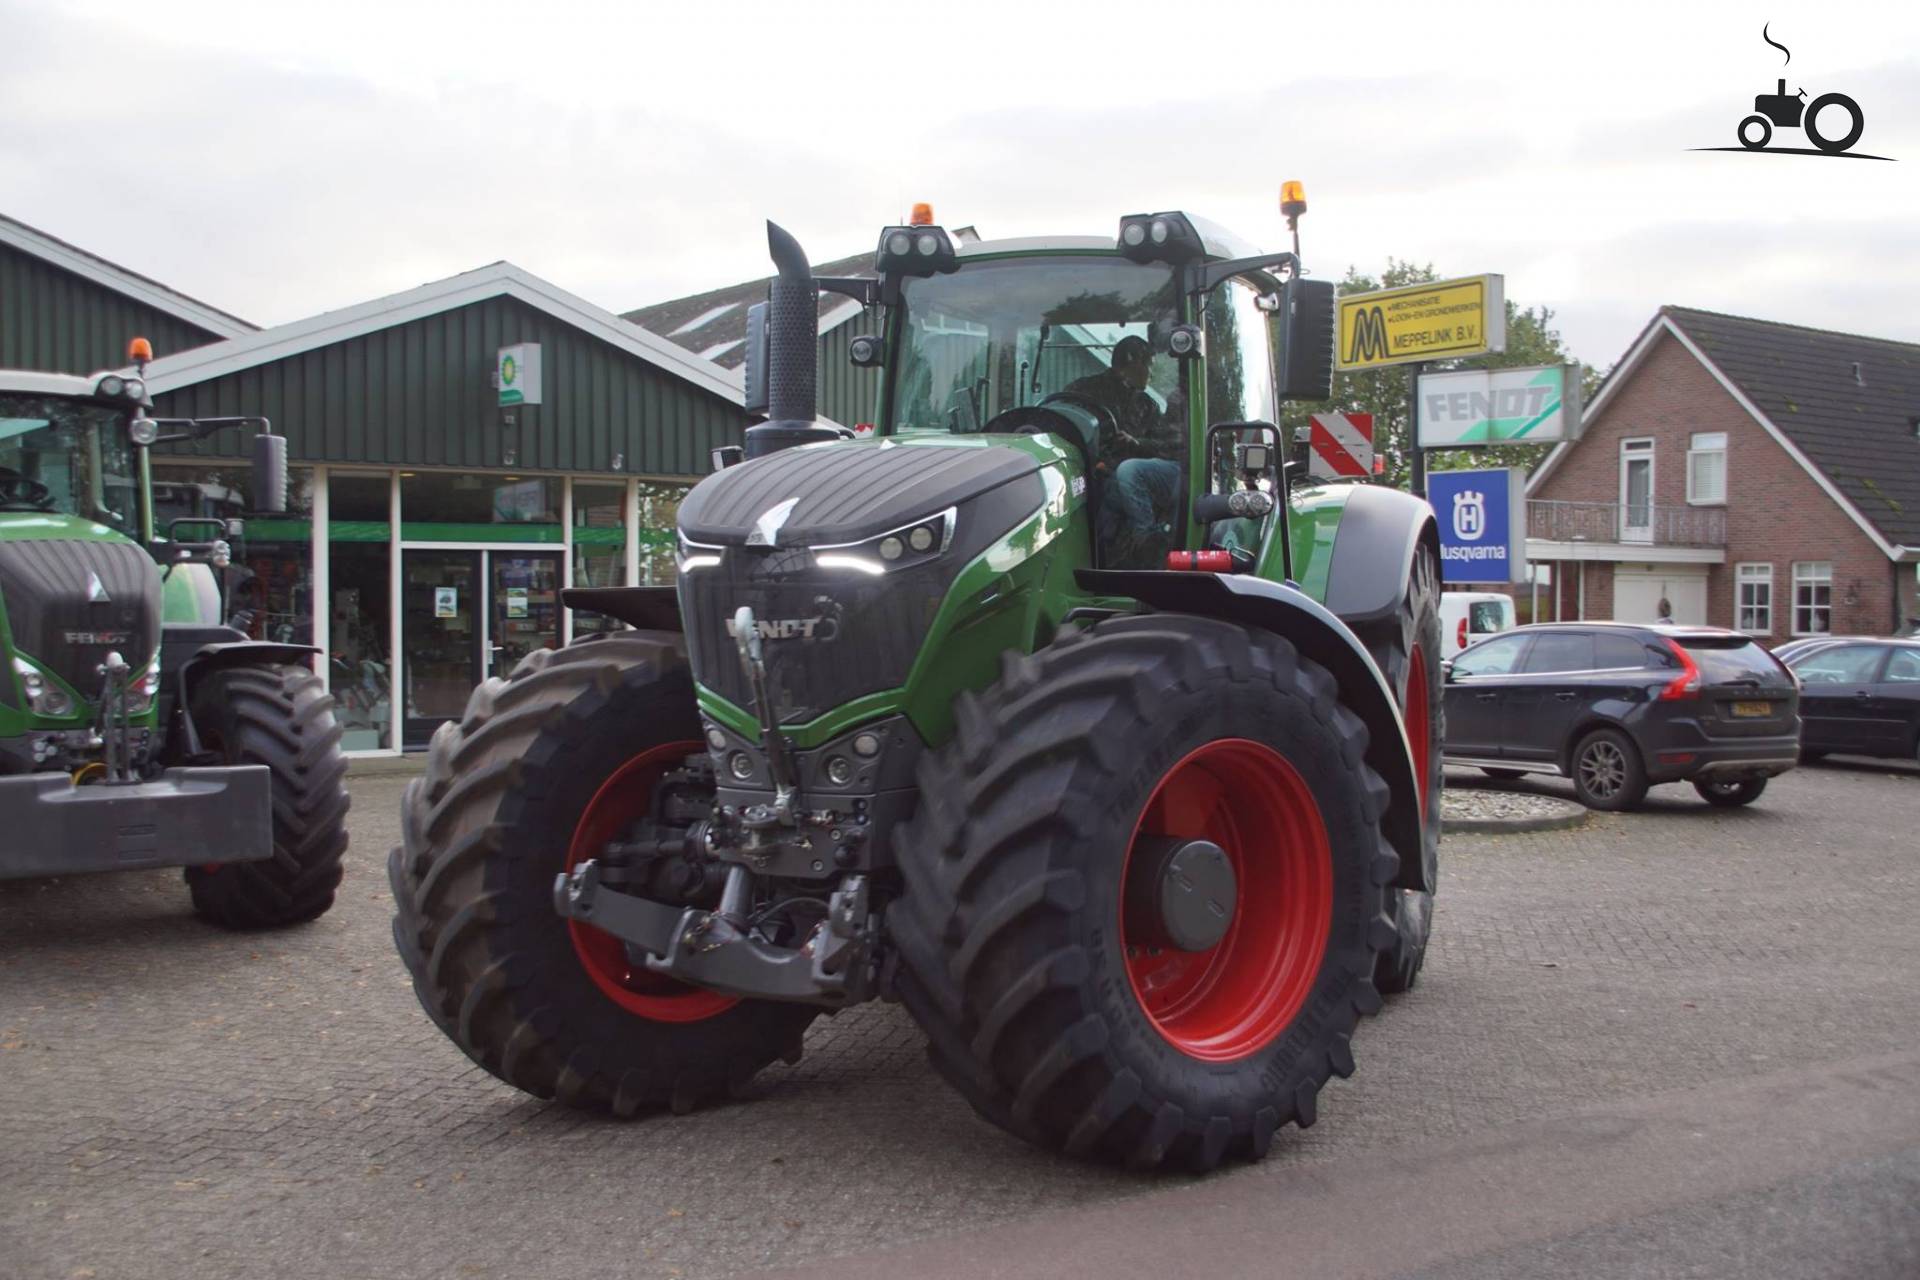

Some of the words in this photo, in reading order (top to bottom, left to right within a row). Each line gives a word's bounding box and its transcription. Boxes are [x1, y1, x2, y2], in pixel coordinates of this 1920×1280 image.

[1393, 328, 1452, 349] MEPPELINK
[1456, 325, 1477, 342] B.V.
[1425, 386, 1553, 422] FENDT
[725, 618, 821, 639] FNDT
